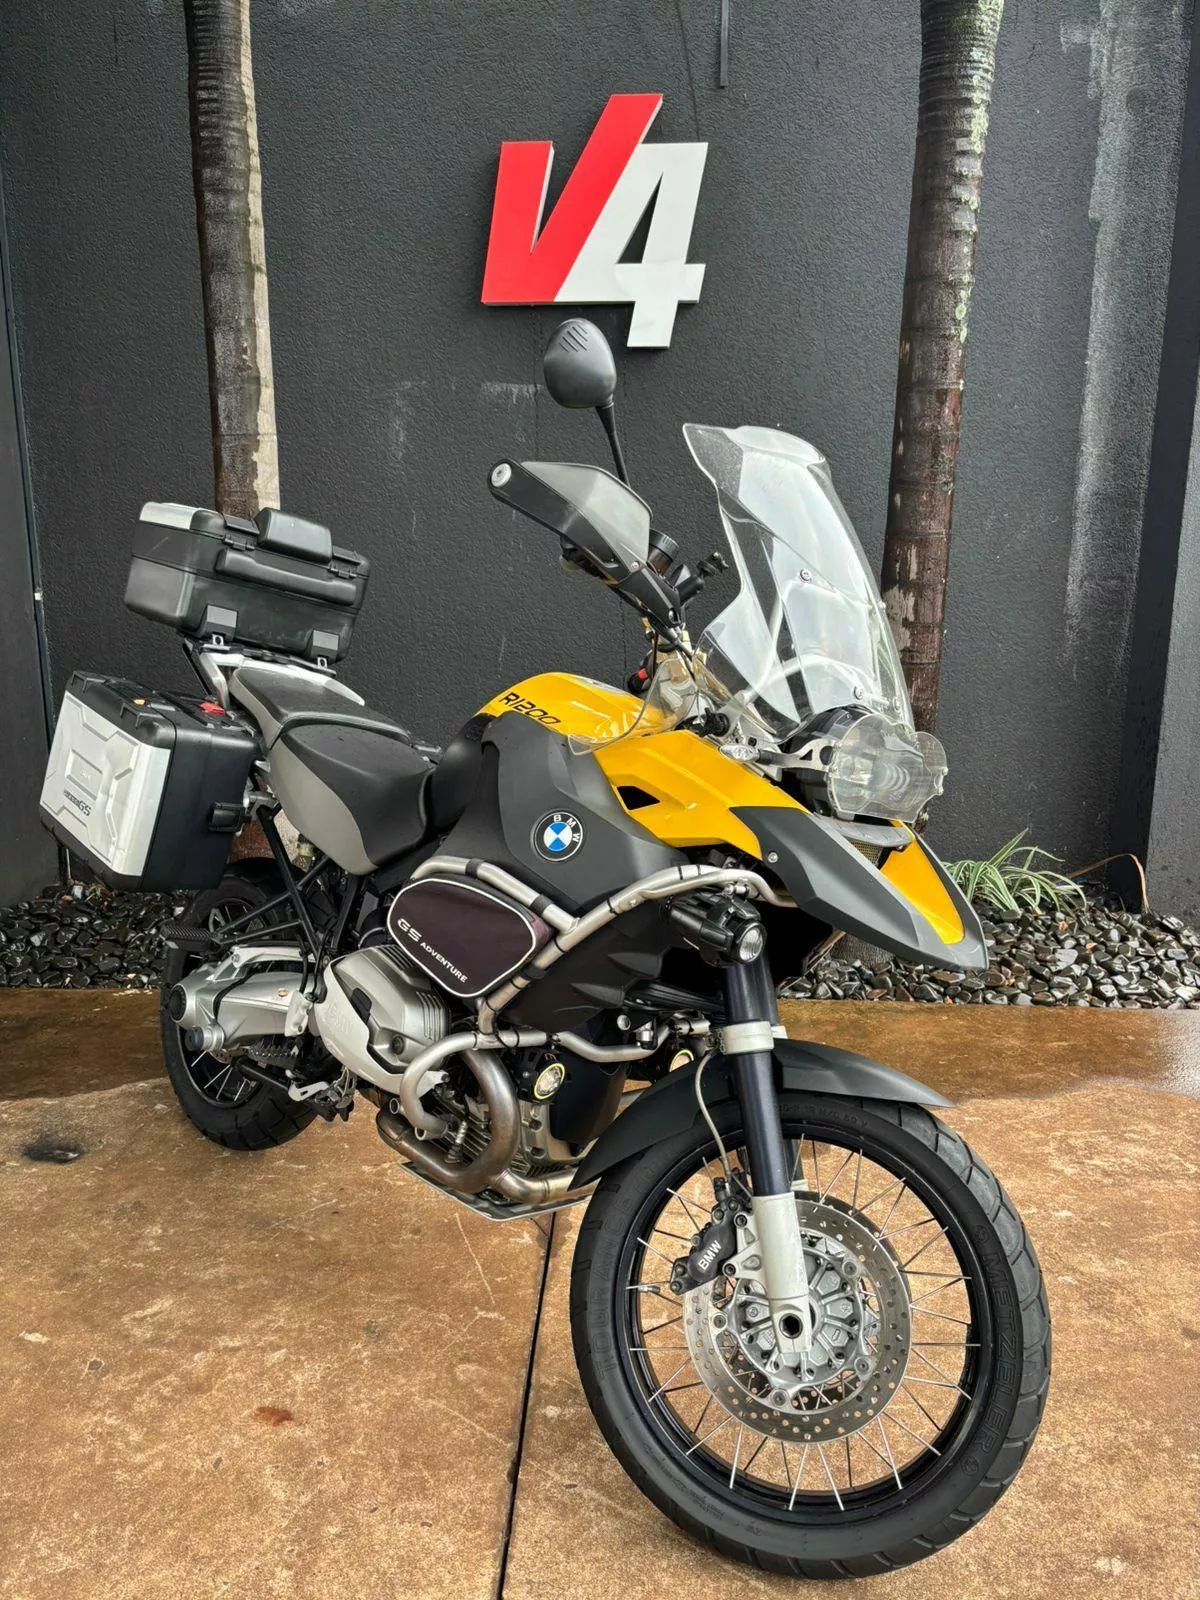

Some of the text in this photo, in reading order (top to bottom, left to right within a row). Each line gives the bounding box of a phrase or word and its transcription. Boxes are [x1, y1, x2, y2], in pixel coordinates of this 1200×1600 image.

[481, 93, 708, 348] V4
[499, 692, 561, 725] R1200
[553, 814, 580, 843] BMW
[397, 918, 468, 984] GS ADVENTURE
[698, 1239, 722, 1271] BMW
[973, 1252, 1018, 1456] METZELER
